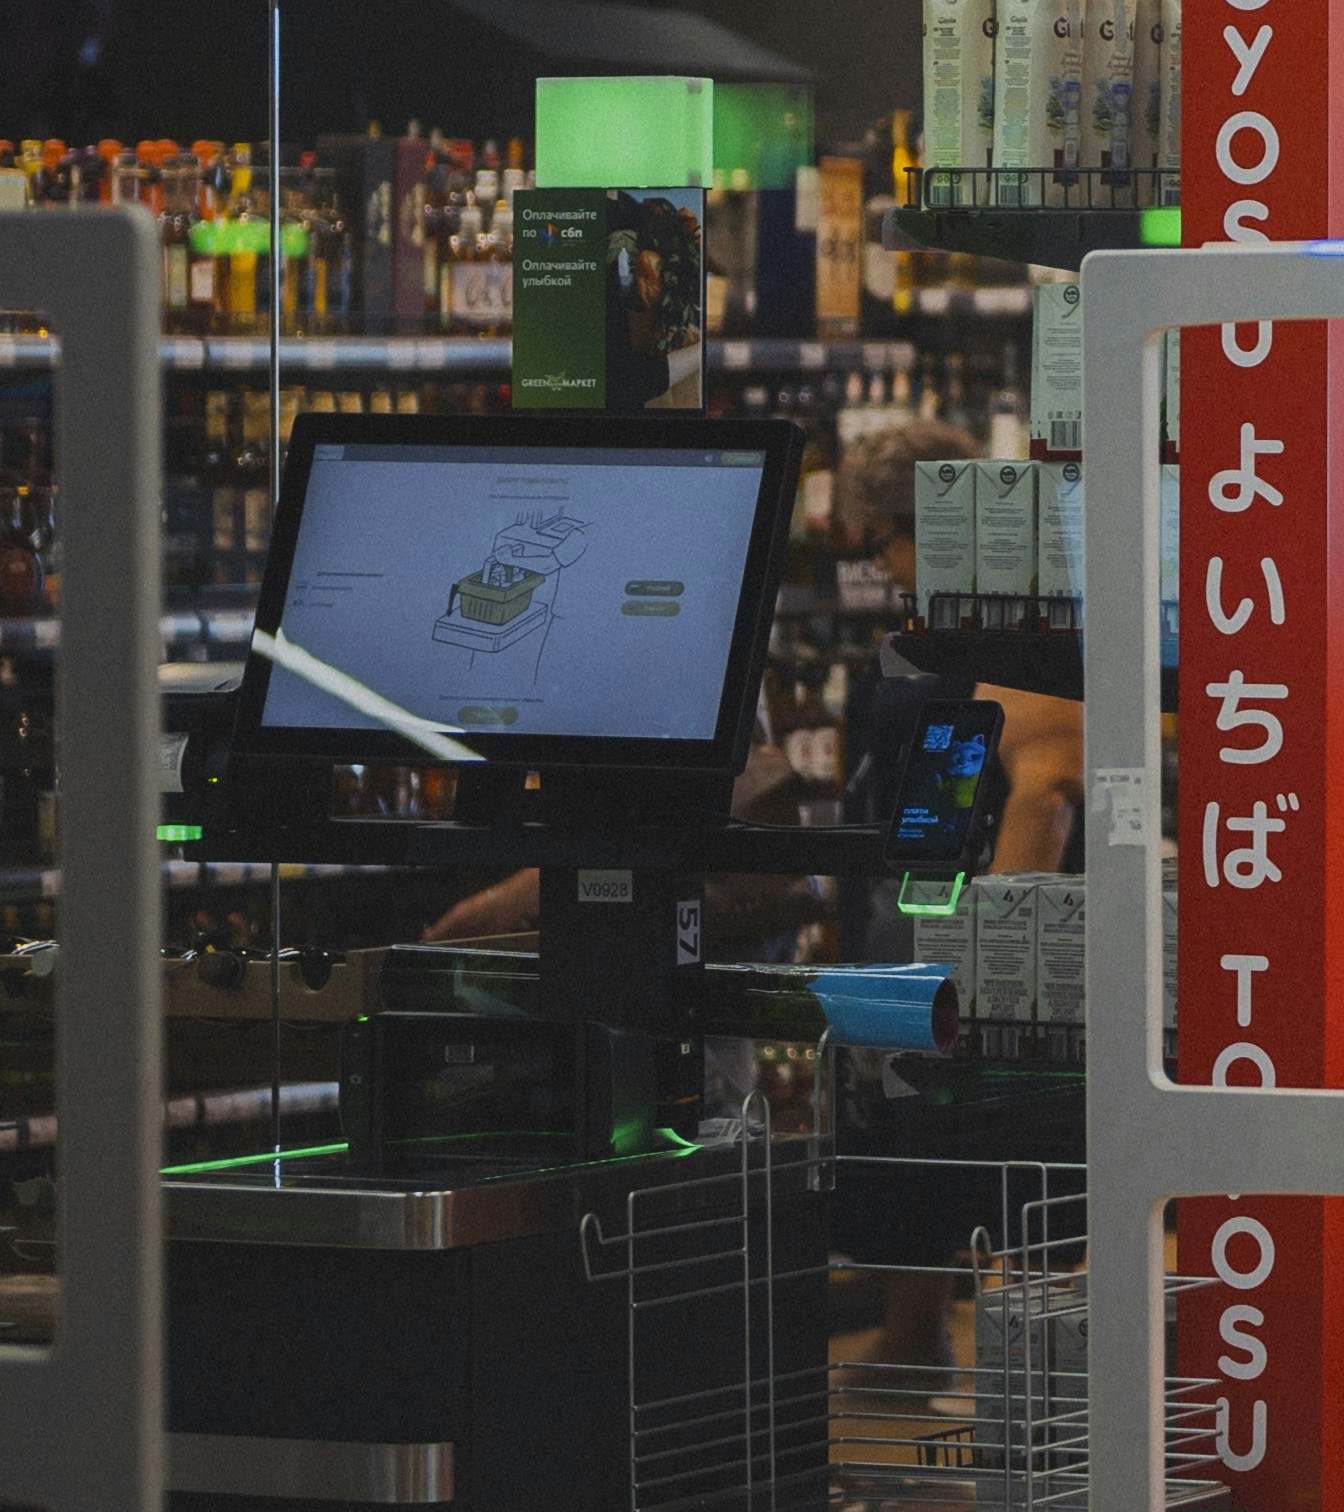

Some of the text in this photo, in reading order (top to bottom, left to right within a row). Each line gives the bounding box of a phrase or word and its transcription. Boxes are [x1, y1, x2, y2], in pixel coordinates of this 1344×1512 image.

[522, 208, 597, 222] Оплачивайте
[522, 226, 583, 239] по сбп
[522, 258, 597, 272] Оплачивайте
[522, 275, 572, 288] улыбкой
[1203, 422, 1300, 889] よいちば
[581, 881, 629, 899] V0928
[678, 907, 698, 957] 57
[1211, 955, 1276, 1472] TOOSU
